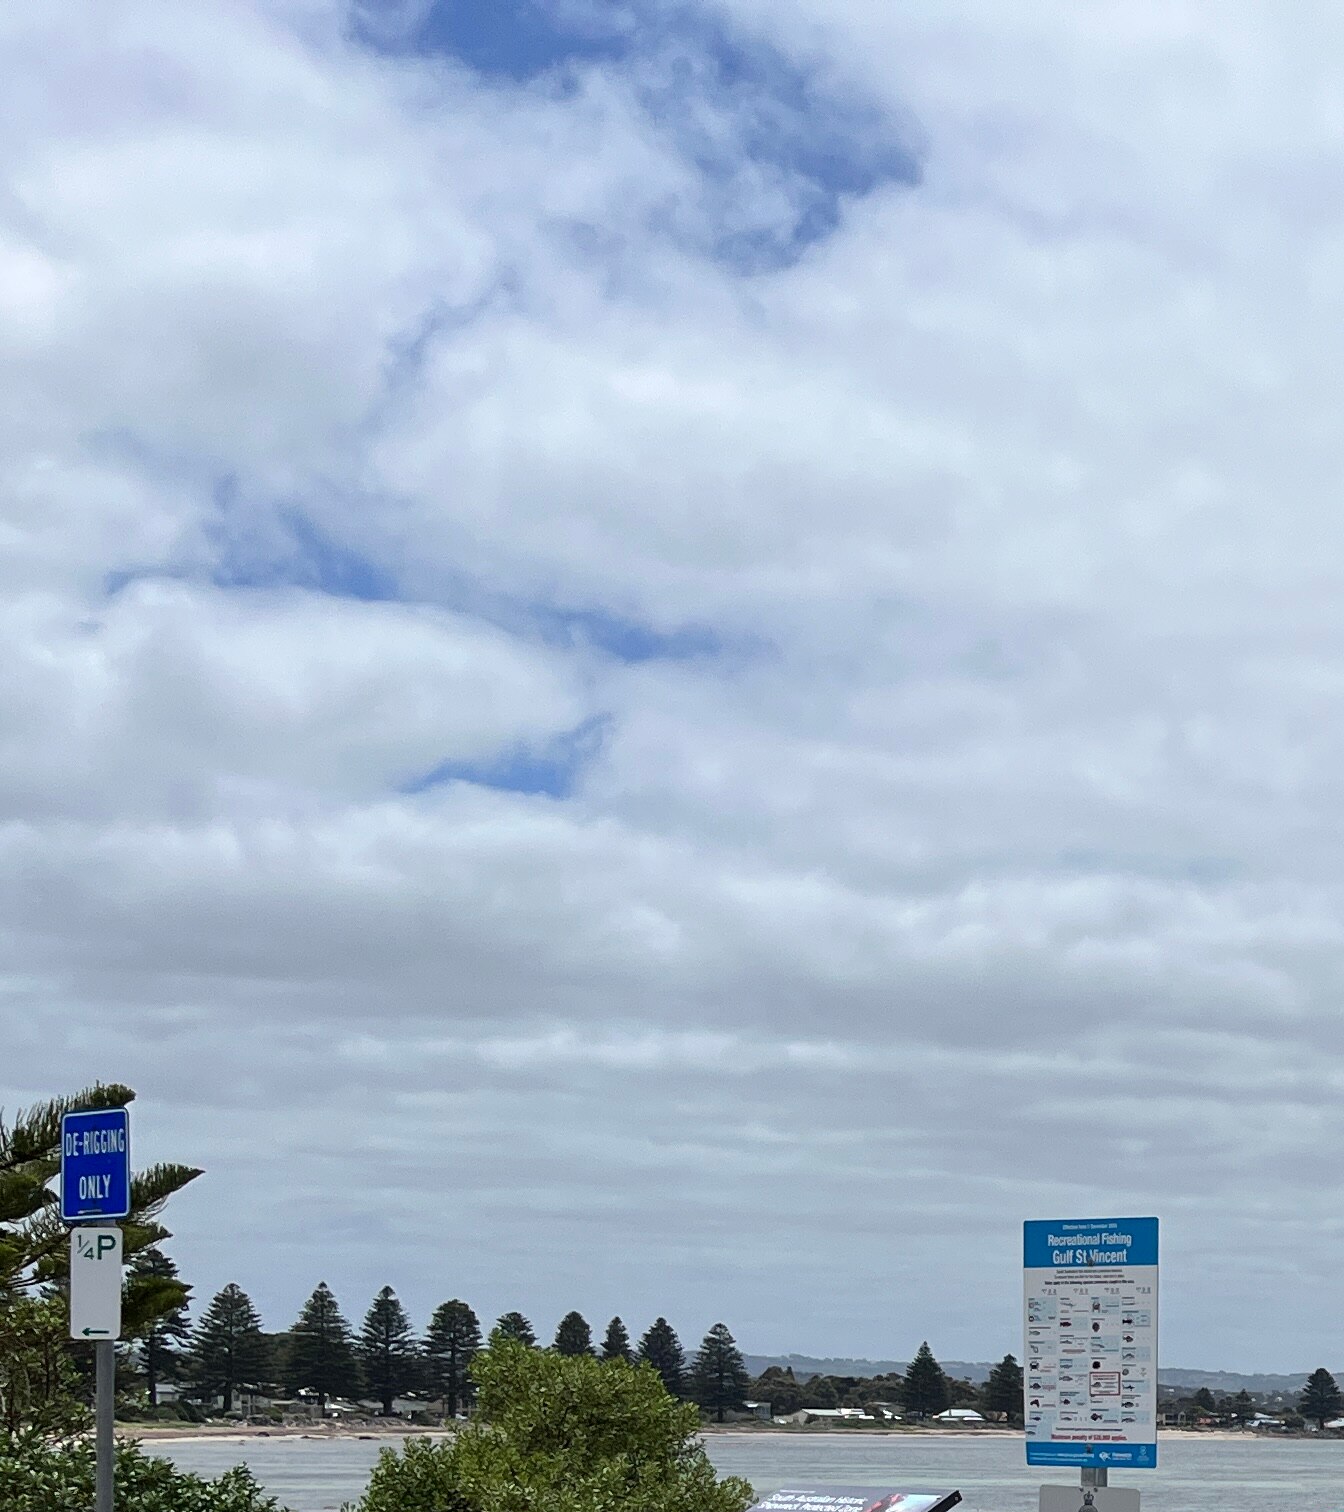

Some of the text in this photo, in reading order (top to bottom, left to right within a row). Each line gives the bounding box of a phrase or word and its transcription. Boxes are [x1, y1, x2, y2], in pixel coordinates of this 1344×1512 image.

[66, 1129, 124, 1156] DE-RIGGING
[79, 1174, 110, 1199] ONLY
[1048, 1233, 1131, 1247] Recreational Fishing
[1053, 1249, 1127, 1264] Gulf St Vincent
